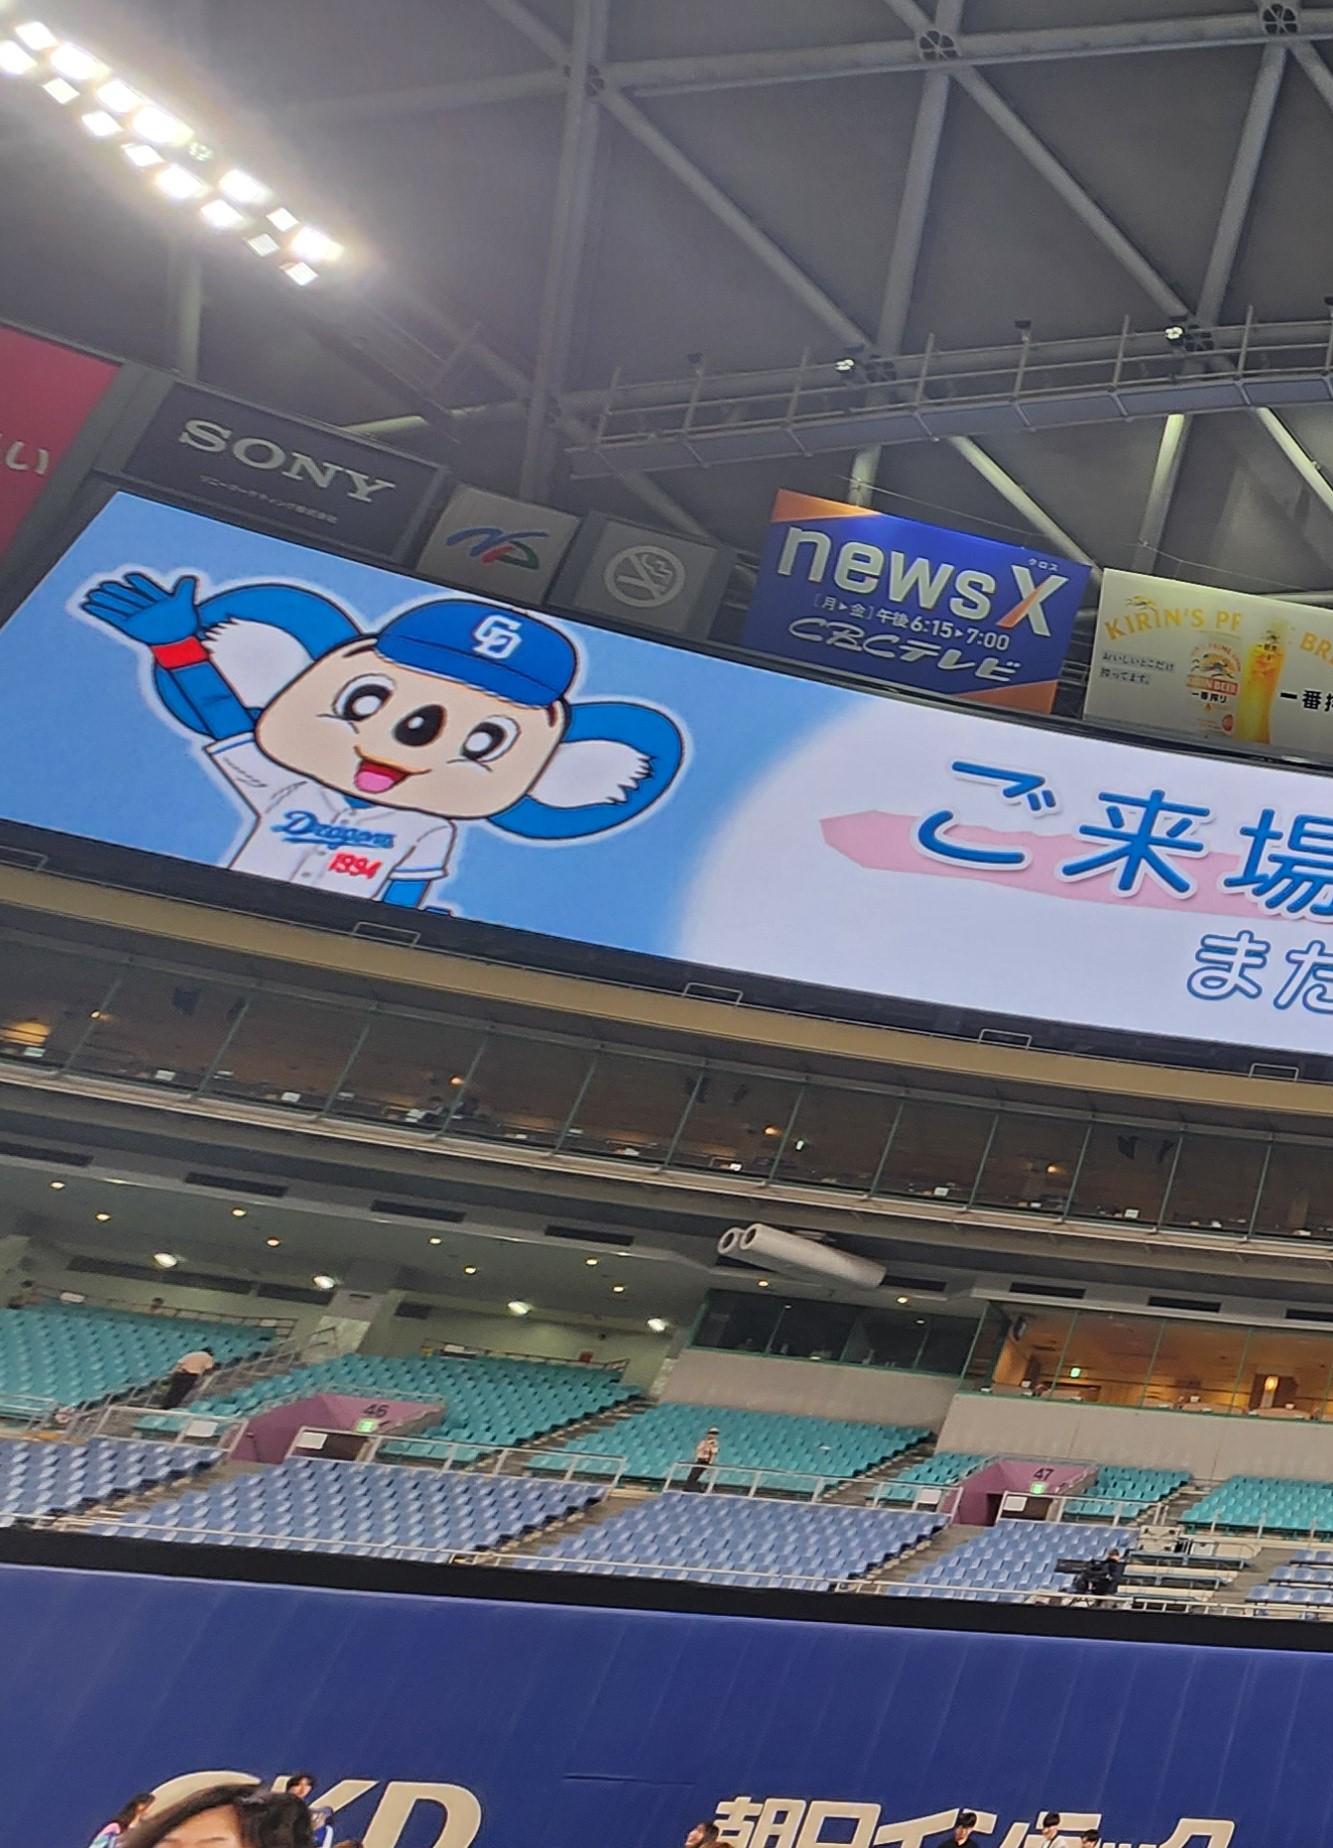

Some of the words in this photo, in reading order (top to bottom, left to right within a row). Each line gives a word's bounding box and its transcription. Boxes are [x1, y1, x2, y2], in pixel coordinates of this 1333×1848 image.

[178, 419, 396, 502] SONY
[1104, 607, 1205, 640] KIRIN'S
[788, 617, 1021, 682] CBCテレビ
[270, 809, 396, 850] Dragons
[328, 852, 383, 880] 1994
[1033, 1467, 1054, 1481] 47
